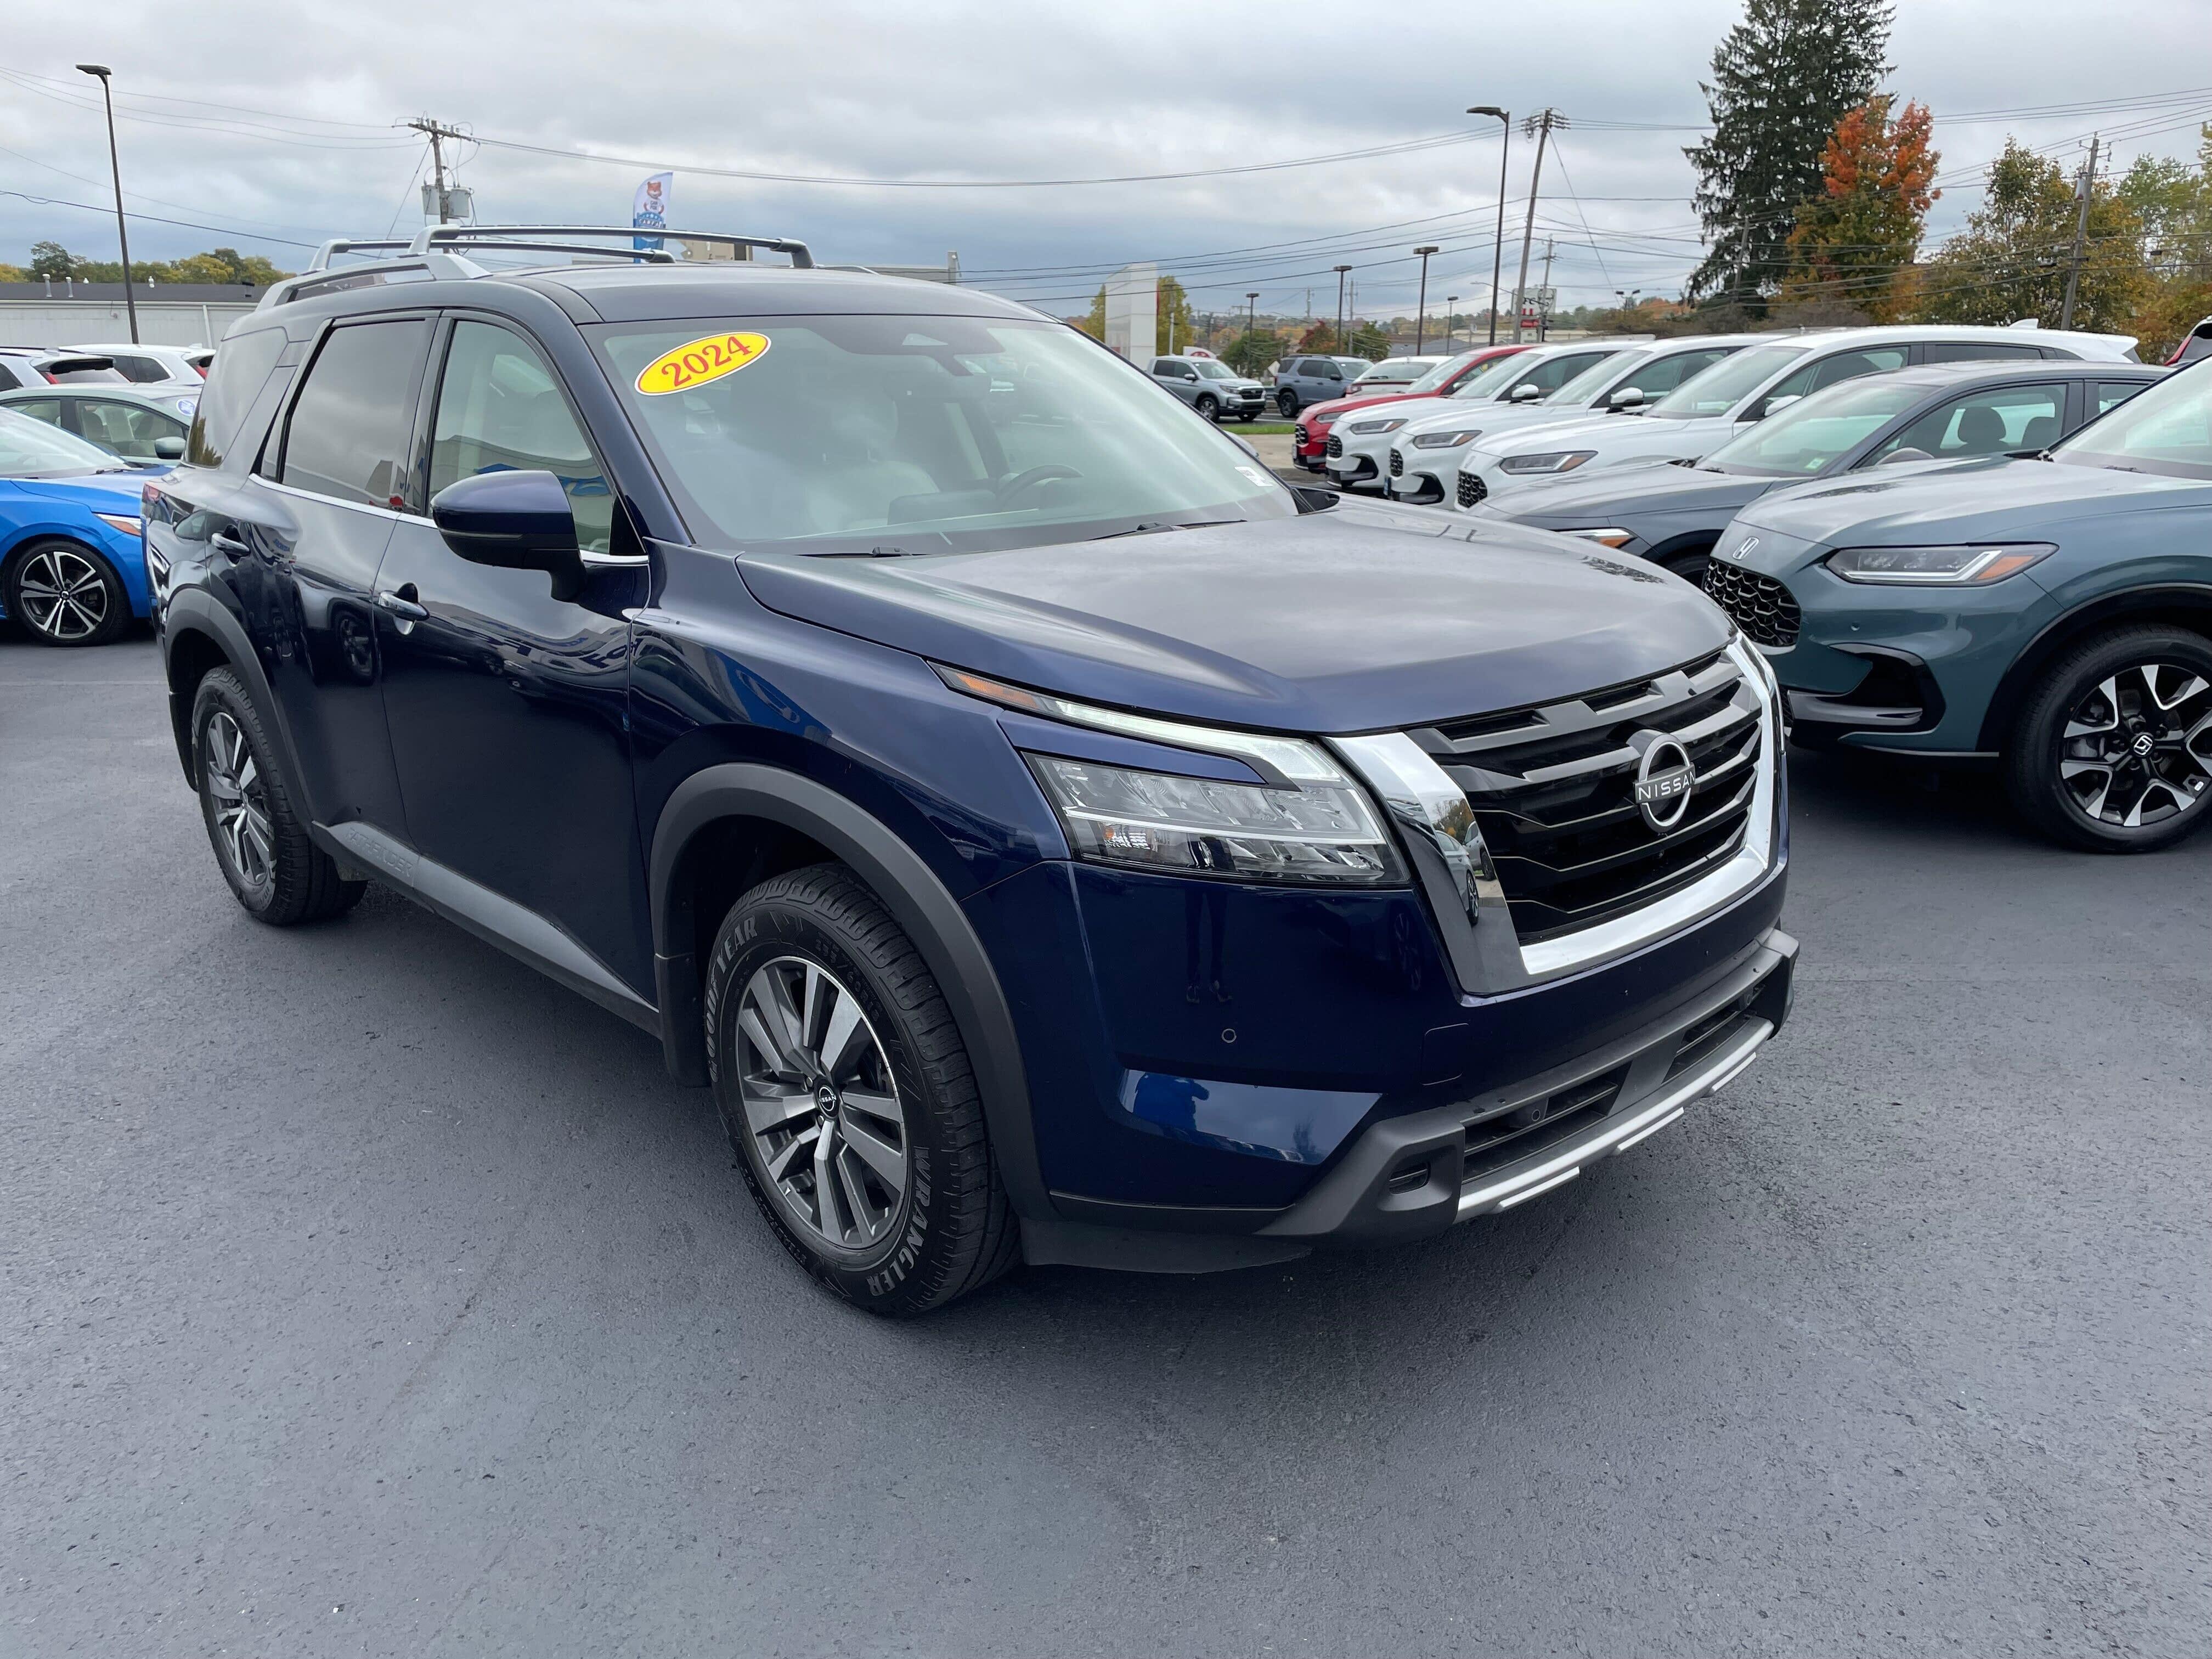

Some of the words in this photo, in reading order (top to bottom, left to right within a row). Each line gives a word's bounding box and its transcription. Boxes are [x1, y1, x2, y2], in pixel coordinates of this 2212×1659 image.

[662, 336, 752, 386] 2024
[1638, 771, 1695, 800] NISSAN
[707, 915, 758, 1082] GOODYEAR
[866, 1146, 932, 1296] WRANGLER
